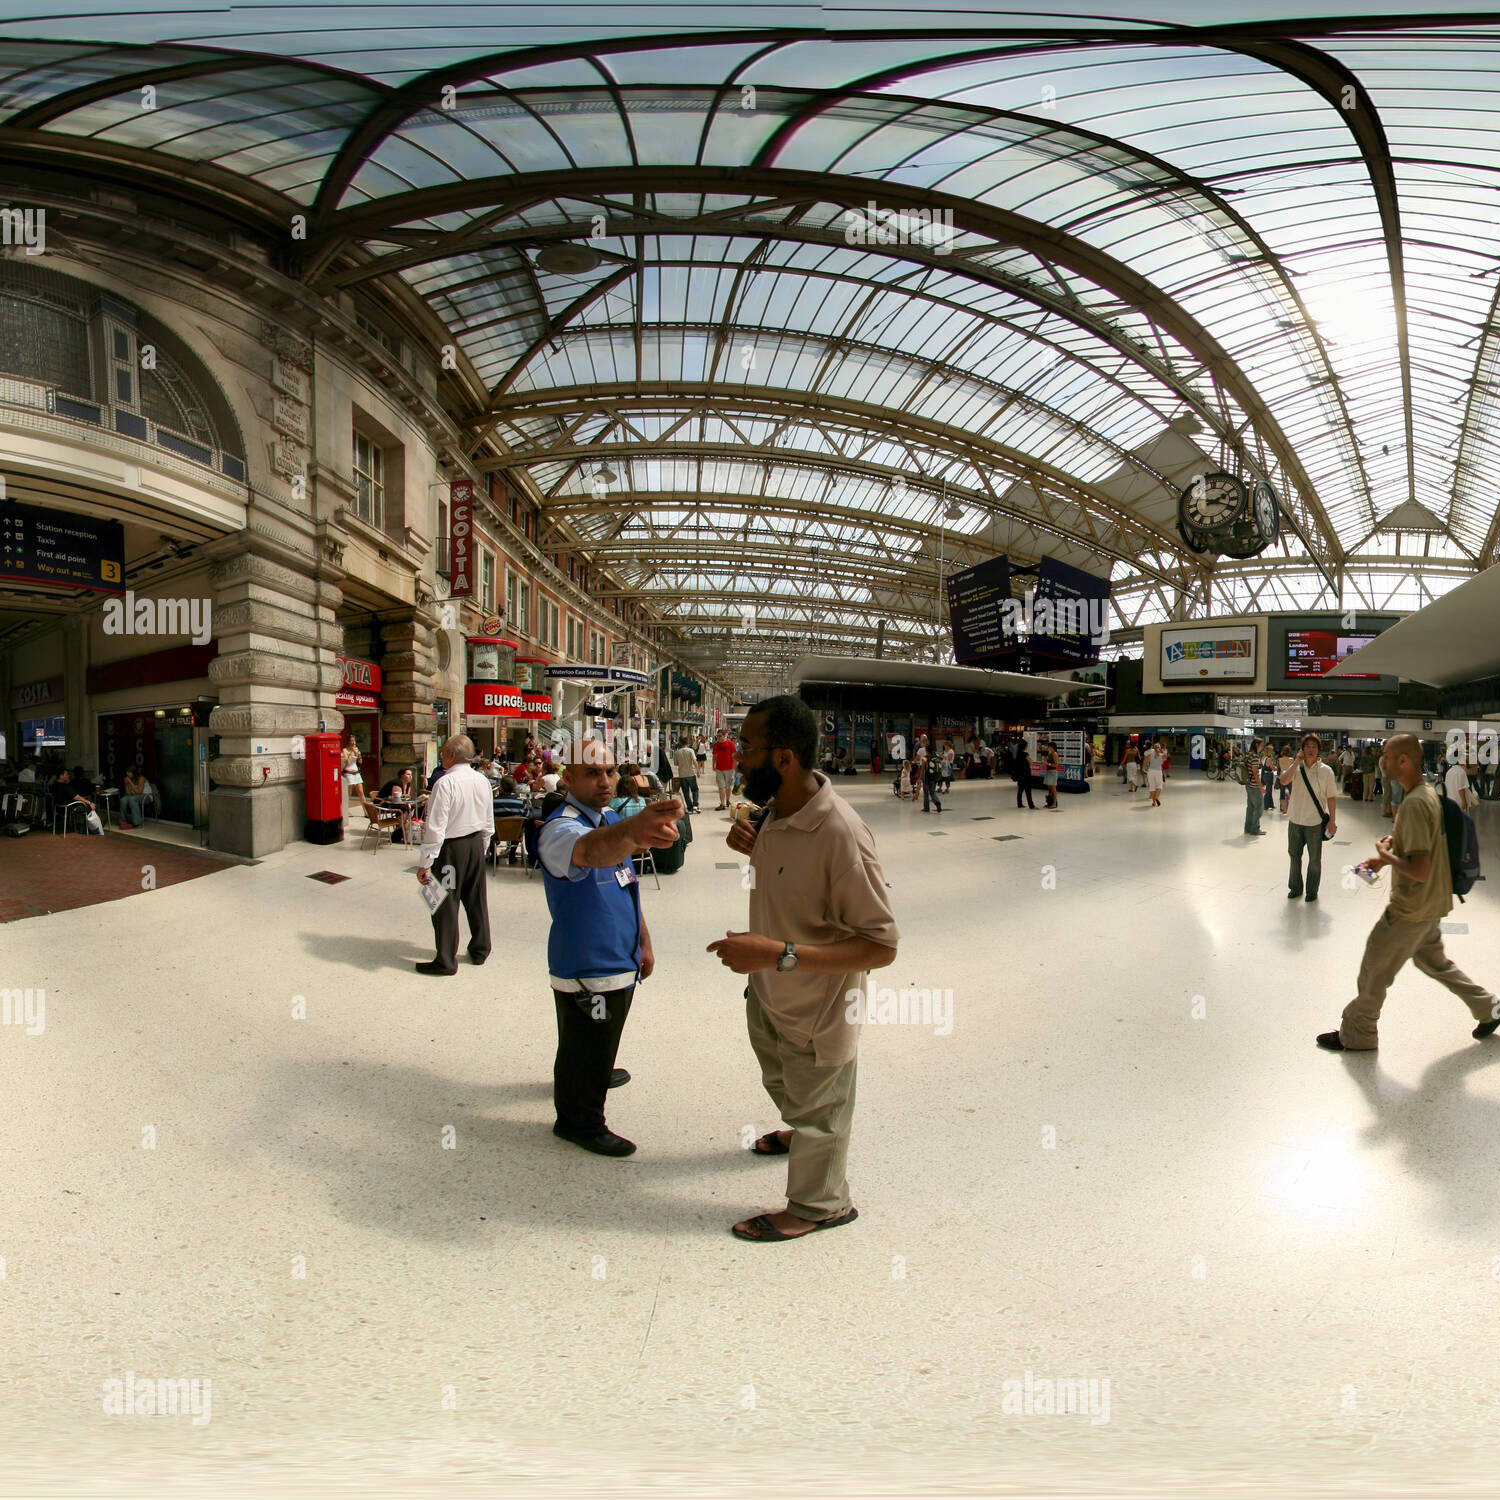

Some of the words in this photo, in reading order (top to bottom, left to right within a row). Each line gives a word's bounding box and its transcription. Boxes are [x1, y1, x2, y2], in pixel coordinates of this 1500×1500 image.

[36, 522, 63, 534] Station
[64, 528, 98, 541] reception
[37, 535, 56, 545] Taxis
[452, 505, 471, 590] COSTA
[36, 549, 54, 559] First
[55, 553, 66, 561] aid
[67, 555, 87, 564] point
[37, 562, 55, 574] Way
[56, 567, 70, 575] out
[106, 563, 116, 579] 3
[485, 622, 501, 633] KING
[1170, 640, 1250, 662] AEGON
[552, 668, 575, 676] Waterloo
[18, 682, 51, 704] COSTA
